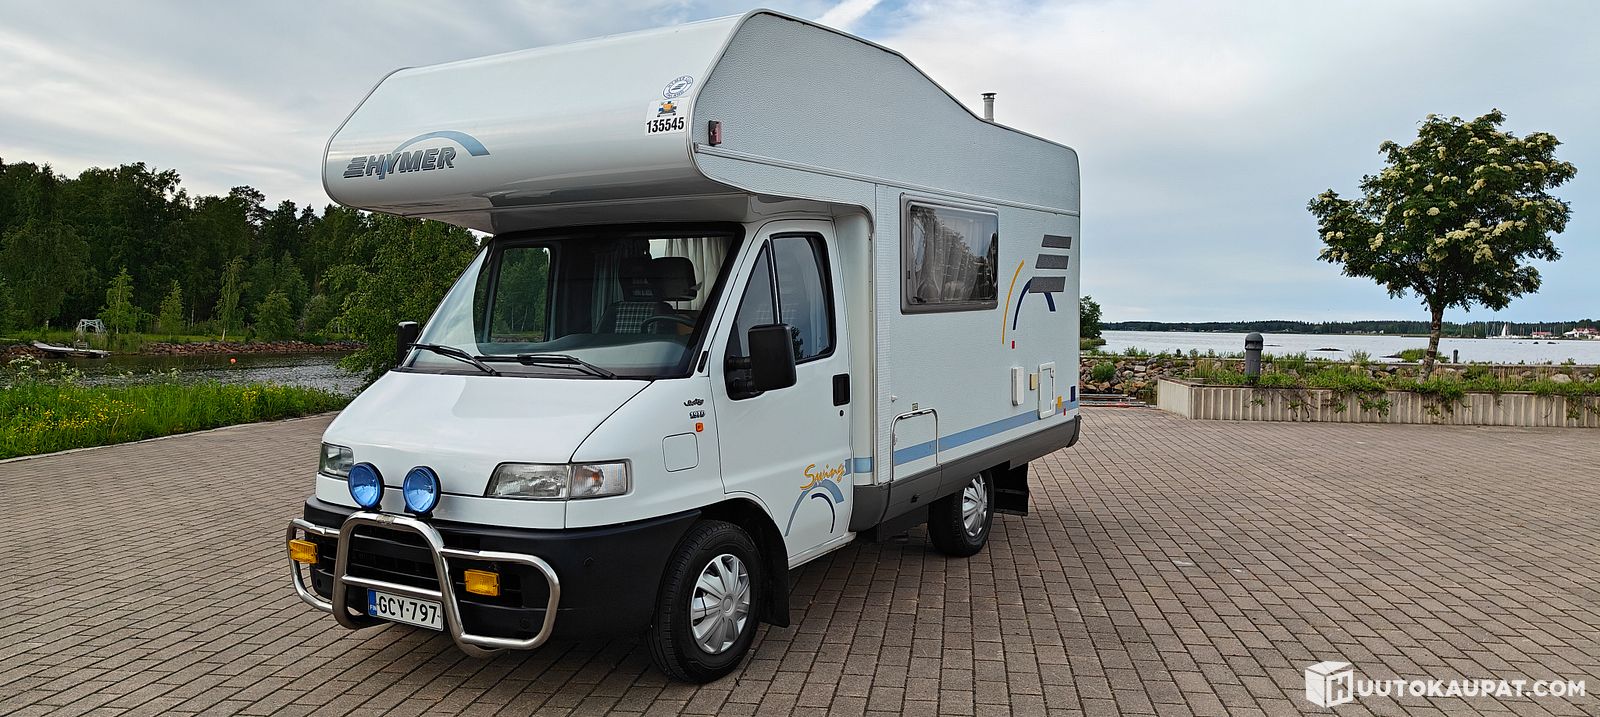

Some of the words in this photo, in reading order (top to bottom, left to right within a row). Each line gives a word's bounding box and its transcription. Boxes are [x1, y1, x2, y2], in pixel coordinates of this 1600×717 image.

[646, 117, 684, 133] 135545
[365, 146, 457, 180] HYMER
[800, 463, 844, 489] Swing
[379, 595, 437, 624] GCY-797
